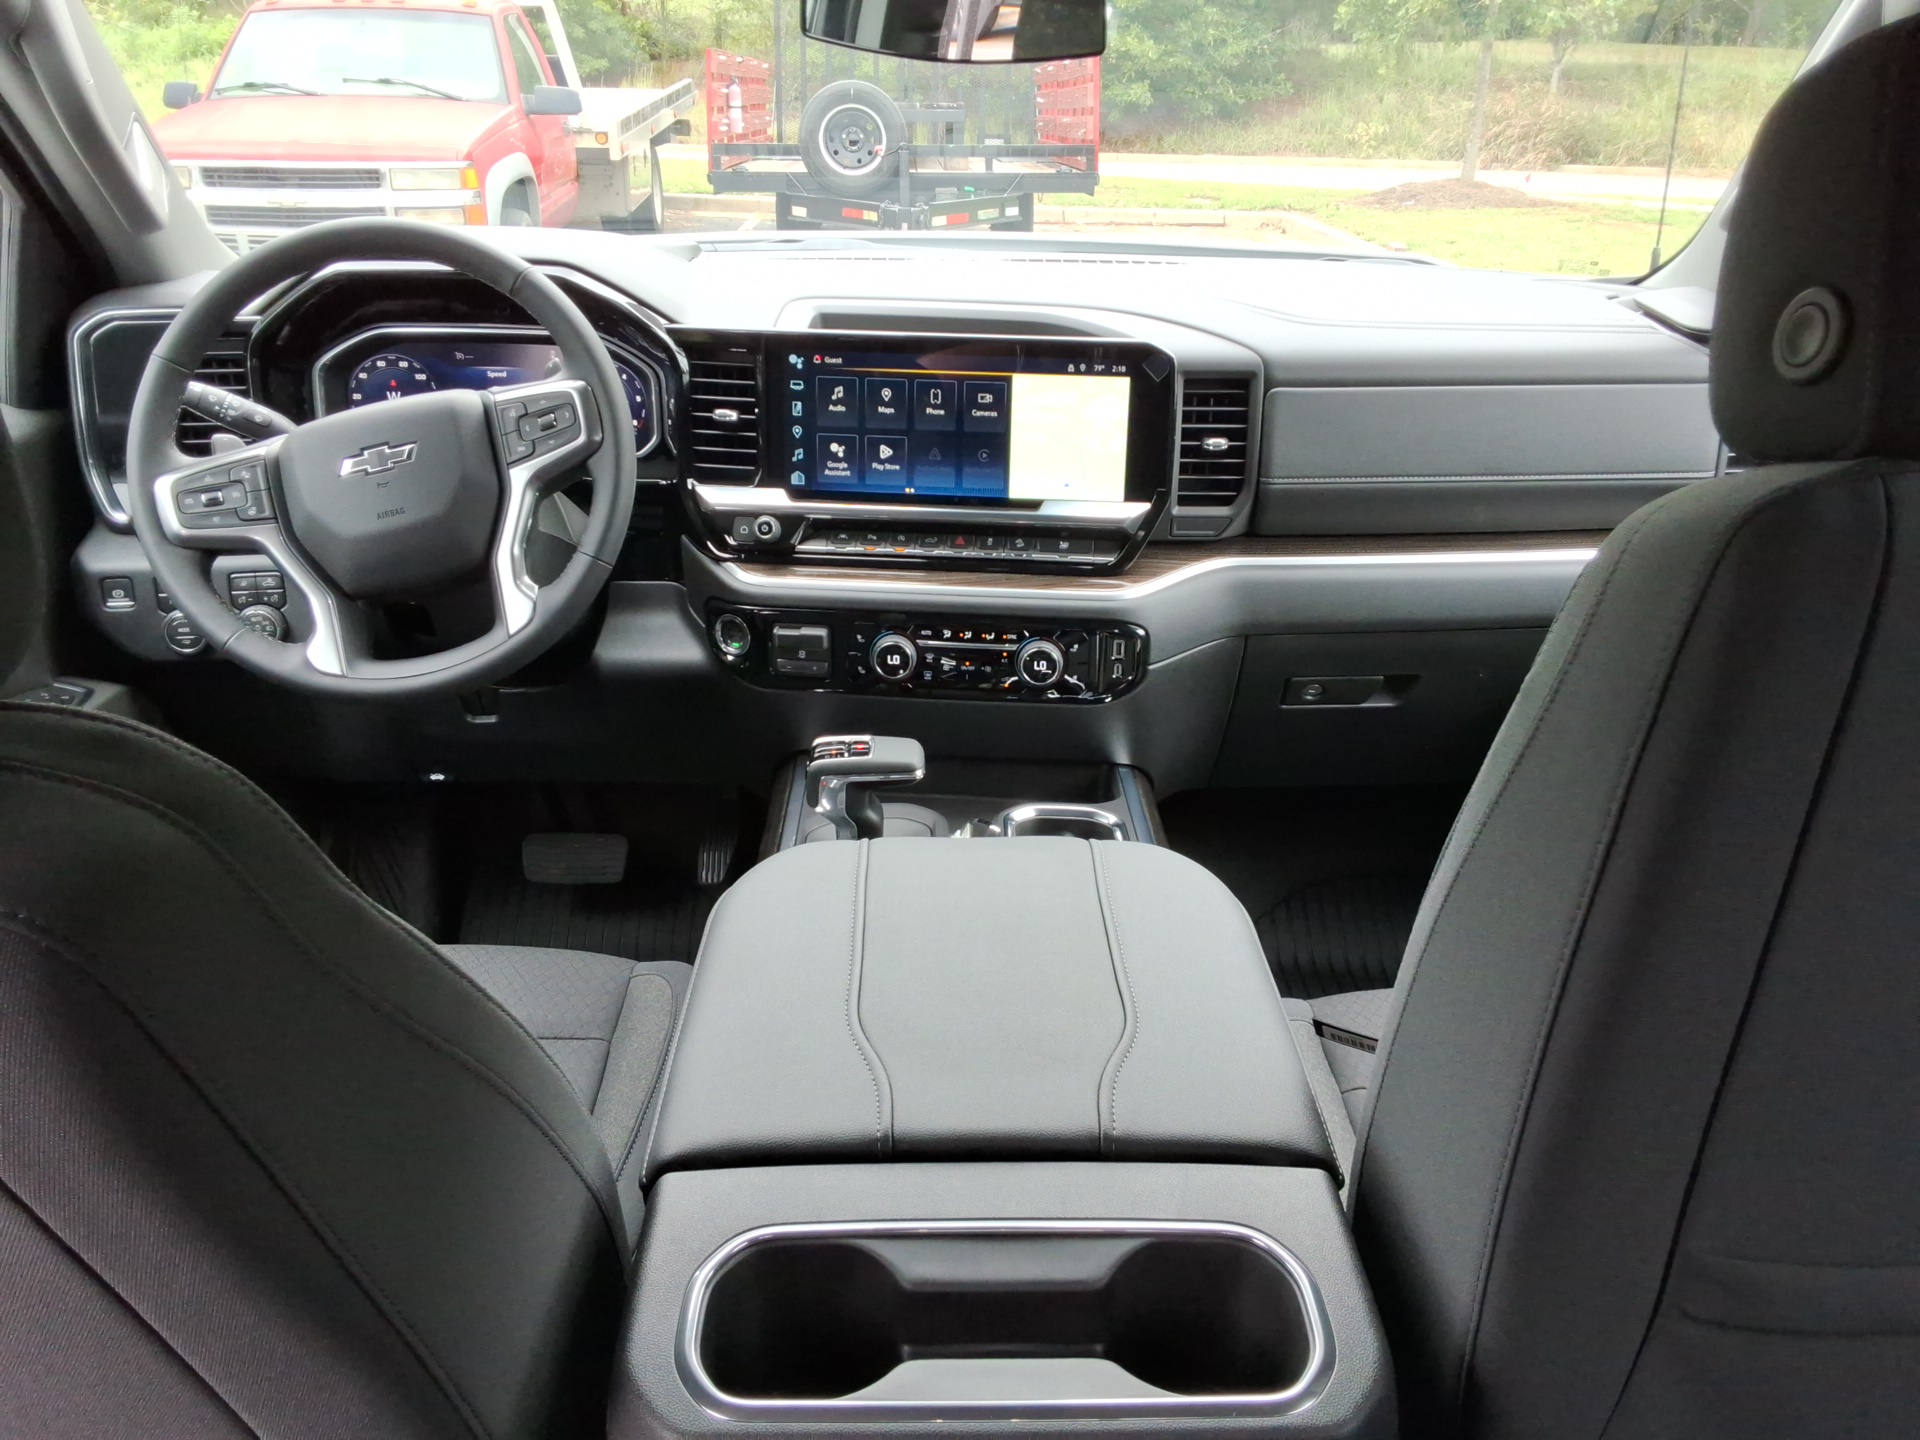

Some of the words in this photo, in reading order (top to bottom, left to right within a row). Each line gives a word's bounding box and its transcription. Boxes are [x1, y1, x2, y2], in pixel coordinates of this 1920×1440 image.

[824, 356, 842, 364] Guest
[486, 370, 507, 379] Speed
[828, 404, 846, 412] Audio
[878, 406, 895, 414] Maps
[926, 407, 945, 415] Phone
[971, 409, 998, 417] Cameras
[827, 461, 848, 471] Google
[872, 462, 884, 471] Play
[885, 463, 900, 471] Store
[824, 469, 850, 477] Assistant
[377, 507, 405, 520] AIRBAG
[1033, 660, 1047, 670] LO
